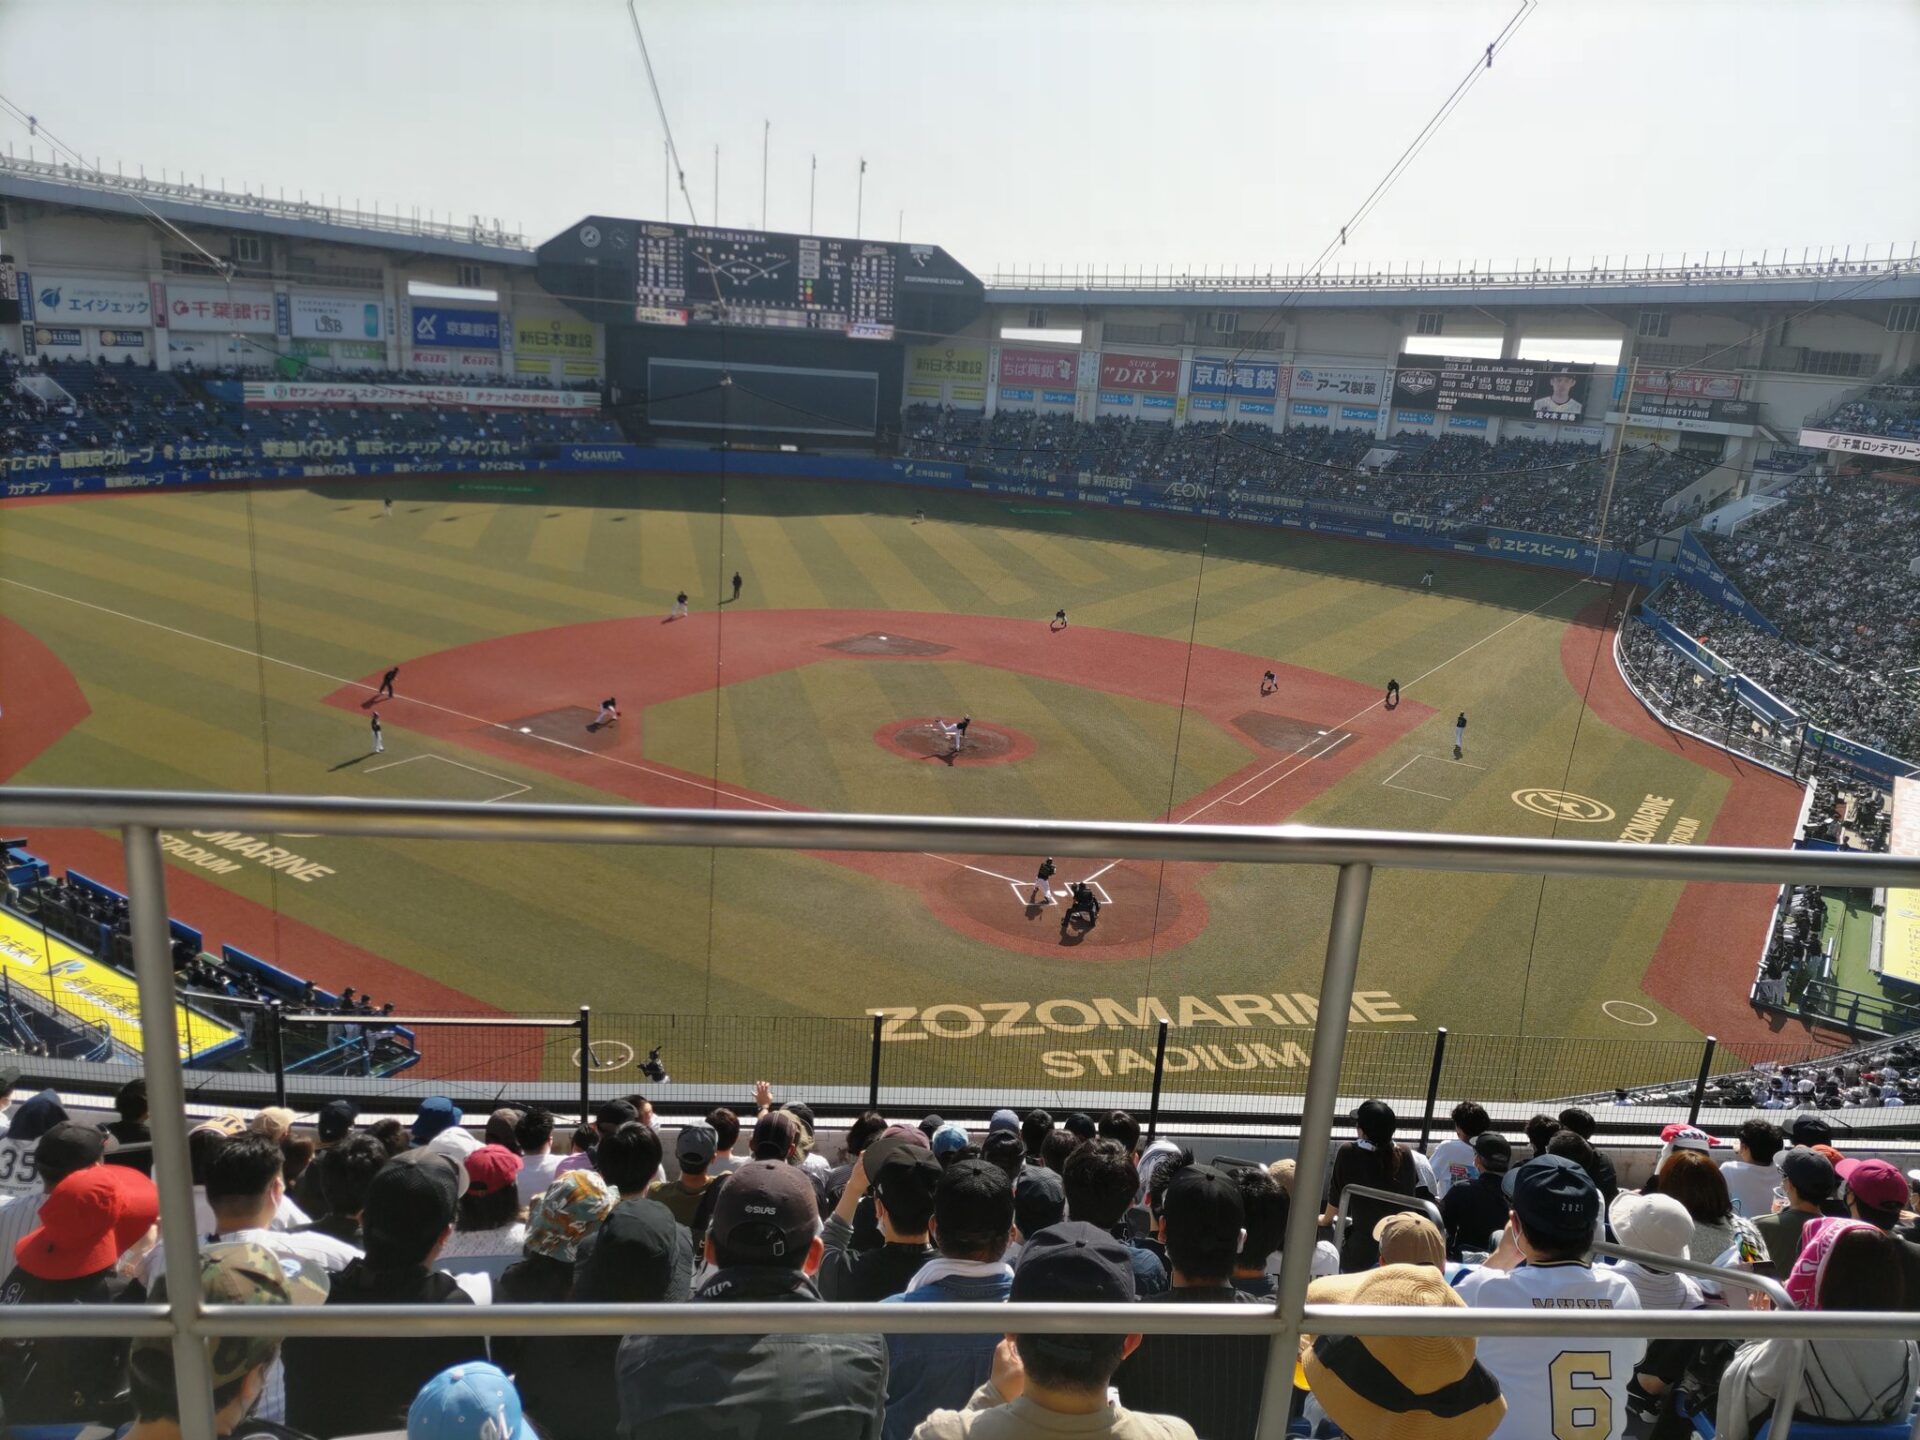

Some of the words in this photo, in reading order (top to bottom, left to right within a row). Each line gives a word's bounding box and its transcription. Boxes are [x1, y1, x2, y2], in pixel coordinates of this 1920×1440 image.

[69, 299, 149, 314] エイジェック
[192, 300, 270, 320] 千葉銀行
[446, 321, 497, 339] 京葉銀行
[519, 331, 592, 349] 新日本建設
[916, 358, 982, 375] 新日本建設
[1128, 359, 1158, 368] SUPER
[1193, 366, 1275, 390] 京成電鉄
[1316, 379, 1376, 395] アース製薬
[1535, 411, 1558, 420] 佐々木
[179, 444, 254, 460] 金太郎ホーム
[356, 441, 441, 455] 東京インテリア
[582, 451, 625, 460] KAKUTA
[8, 482, 51, 495] カナデン
[1042, 1040, 1312, 1080] STADIUM
[0, 1150, 38, 1183] 35
[1548, 1350, 1613, 1440] 6
